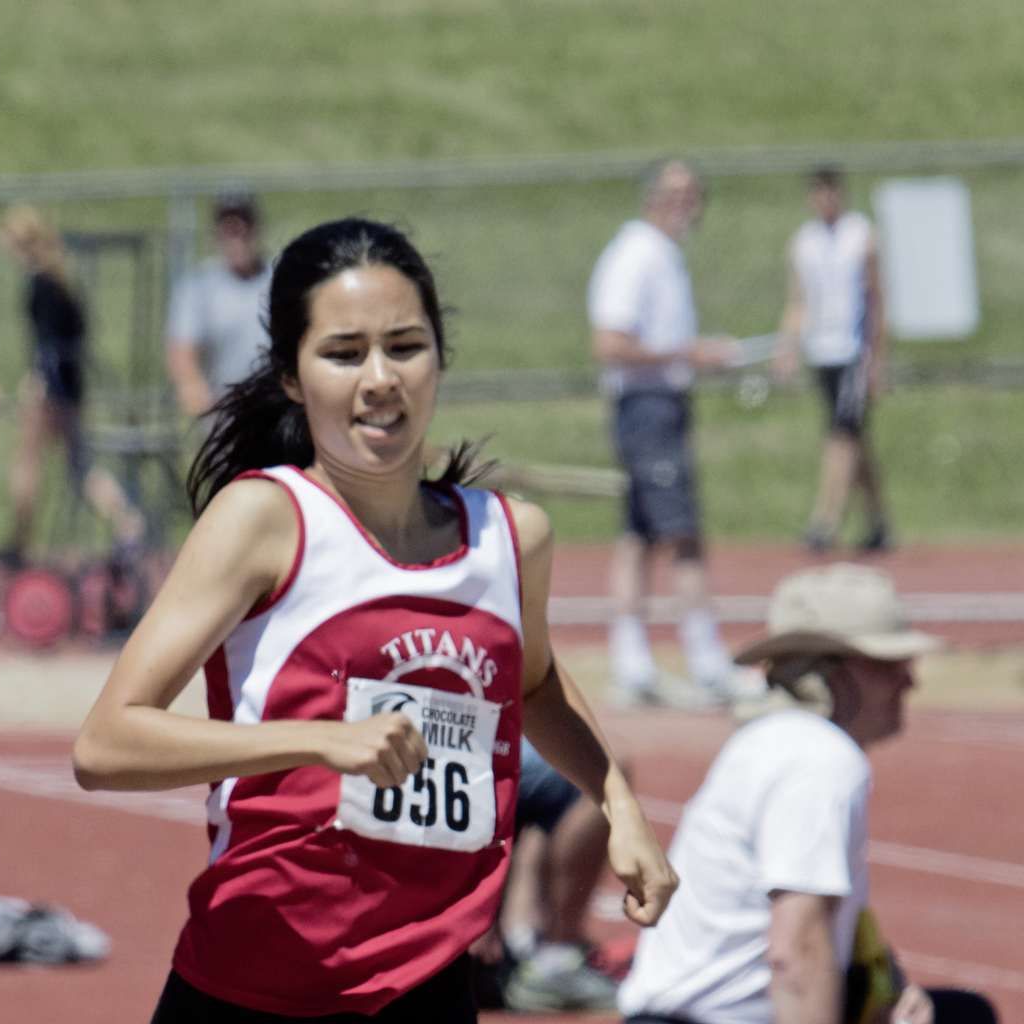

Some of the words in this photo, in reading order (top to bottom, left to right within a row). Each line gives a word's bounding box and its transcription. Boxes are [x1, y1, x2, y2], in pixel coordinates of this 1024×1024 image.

[381, 628, 497, 687] TITANS
[422, 707, 476, 728] CHOCOLATE
[422, 721, 473, 753] MILK
